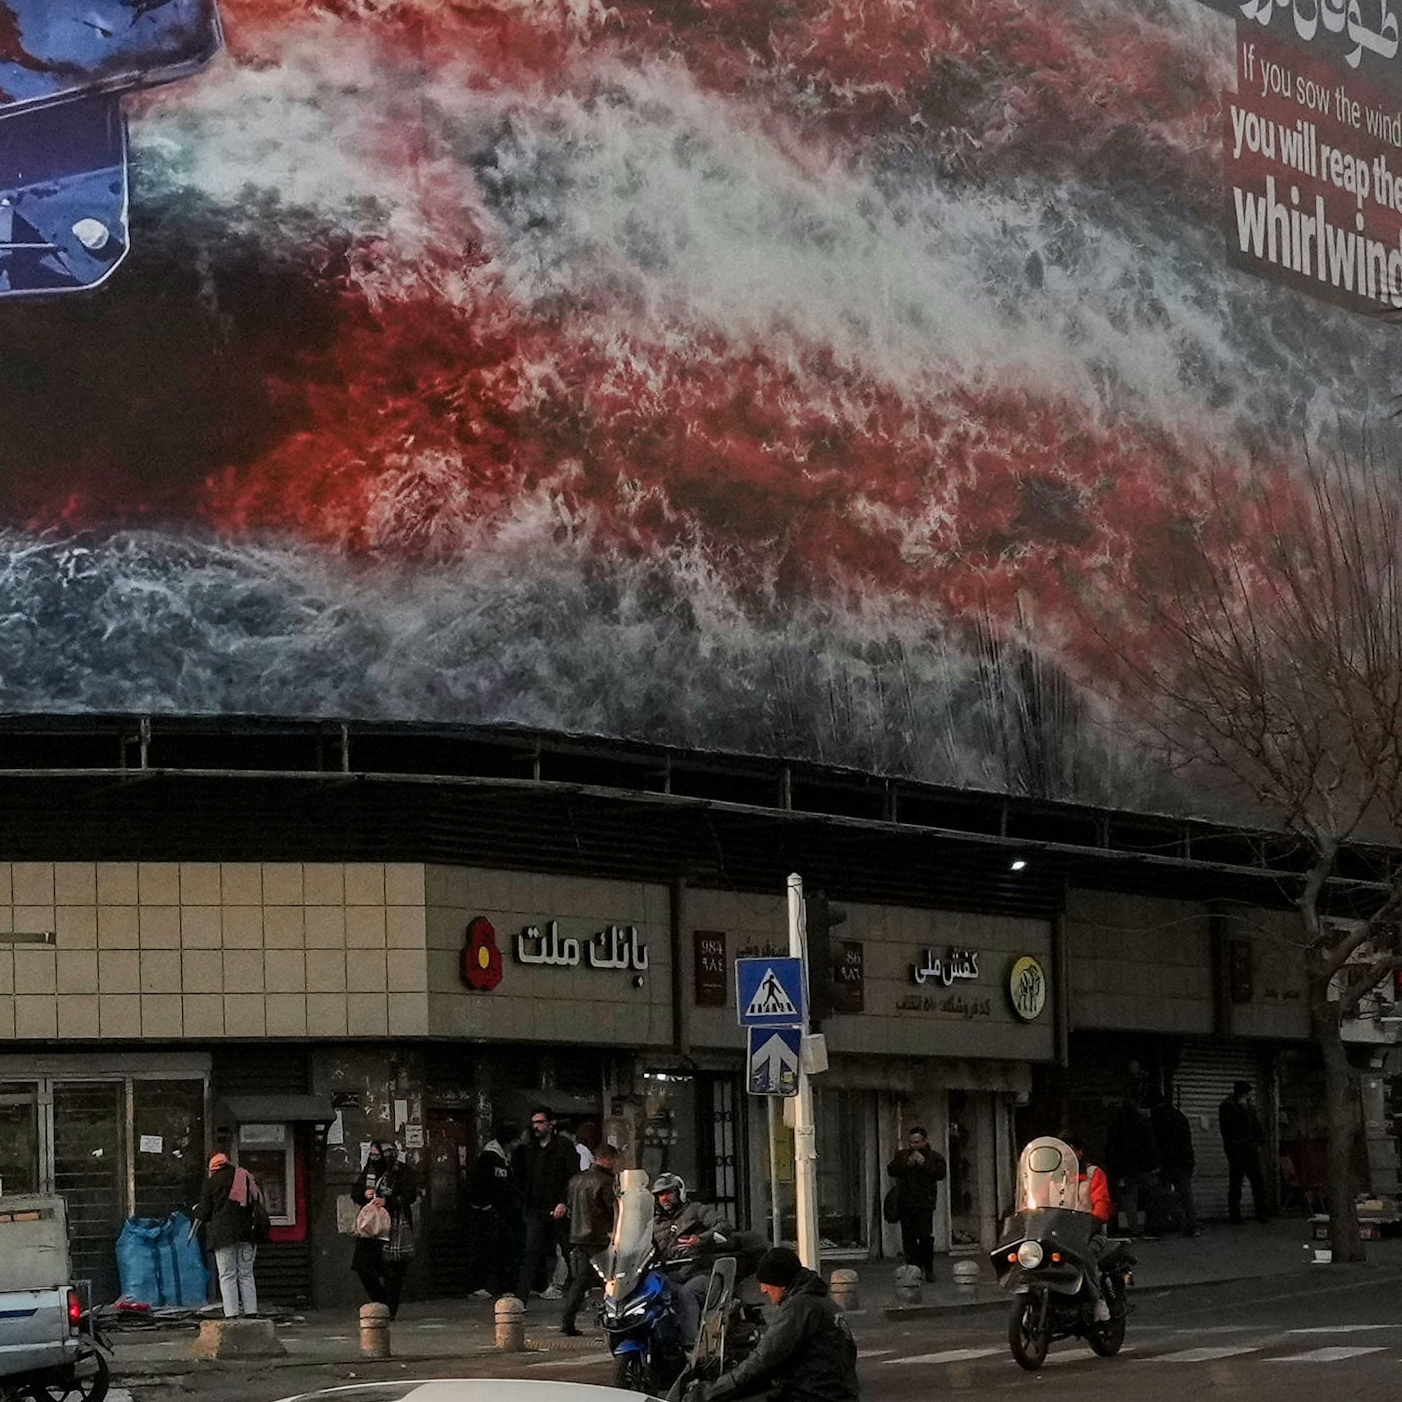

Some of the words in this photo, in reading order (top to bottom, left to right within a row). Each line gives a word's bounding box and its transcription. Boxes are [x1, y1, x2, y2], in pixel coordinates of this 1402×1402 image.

[1242, 41, 1256, 82] If
[1260, 58, 1292, 98] you
[1296, 75, 1331, 115] sow
[1334, 85, 1362, 128] the
[1365, 102, 1402, 148] wind
[1231, 103, 1276, 159] you
[1278, 118, 1317, 177] will
[1321, 144, 1370, 210] reap
[1373, 156, 1402, 214] the
[1232, 174, 1402, 309] whirlwind
[517, 920, 580, 966] ملت
[701, 939, 724, 956] 984
[914, 949, 941, 984] ملی
[942, 948, 979, 986] کفش
